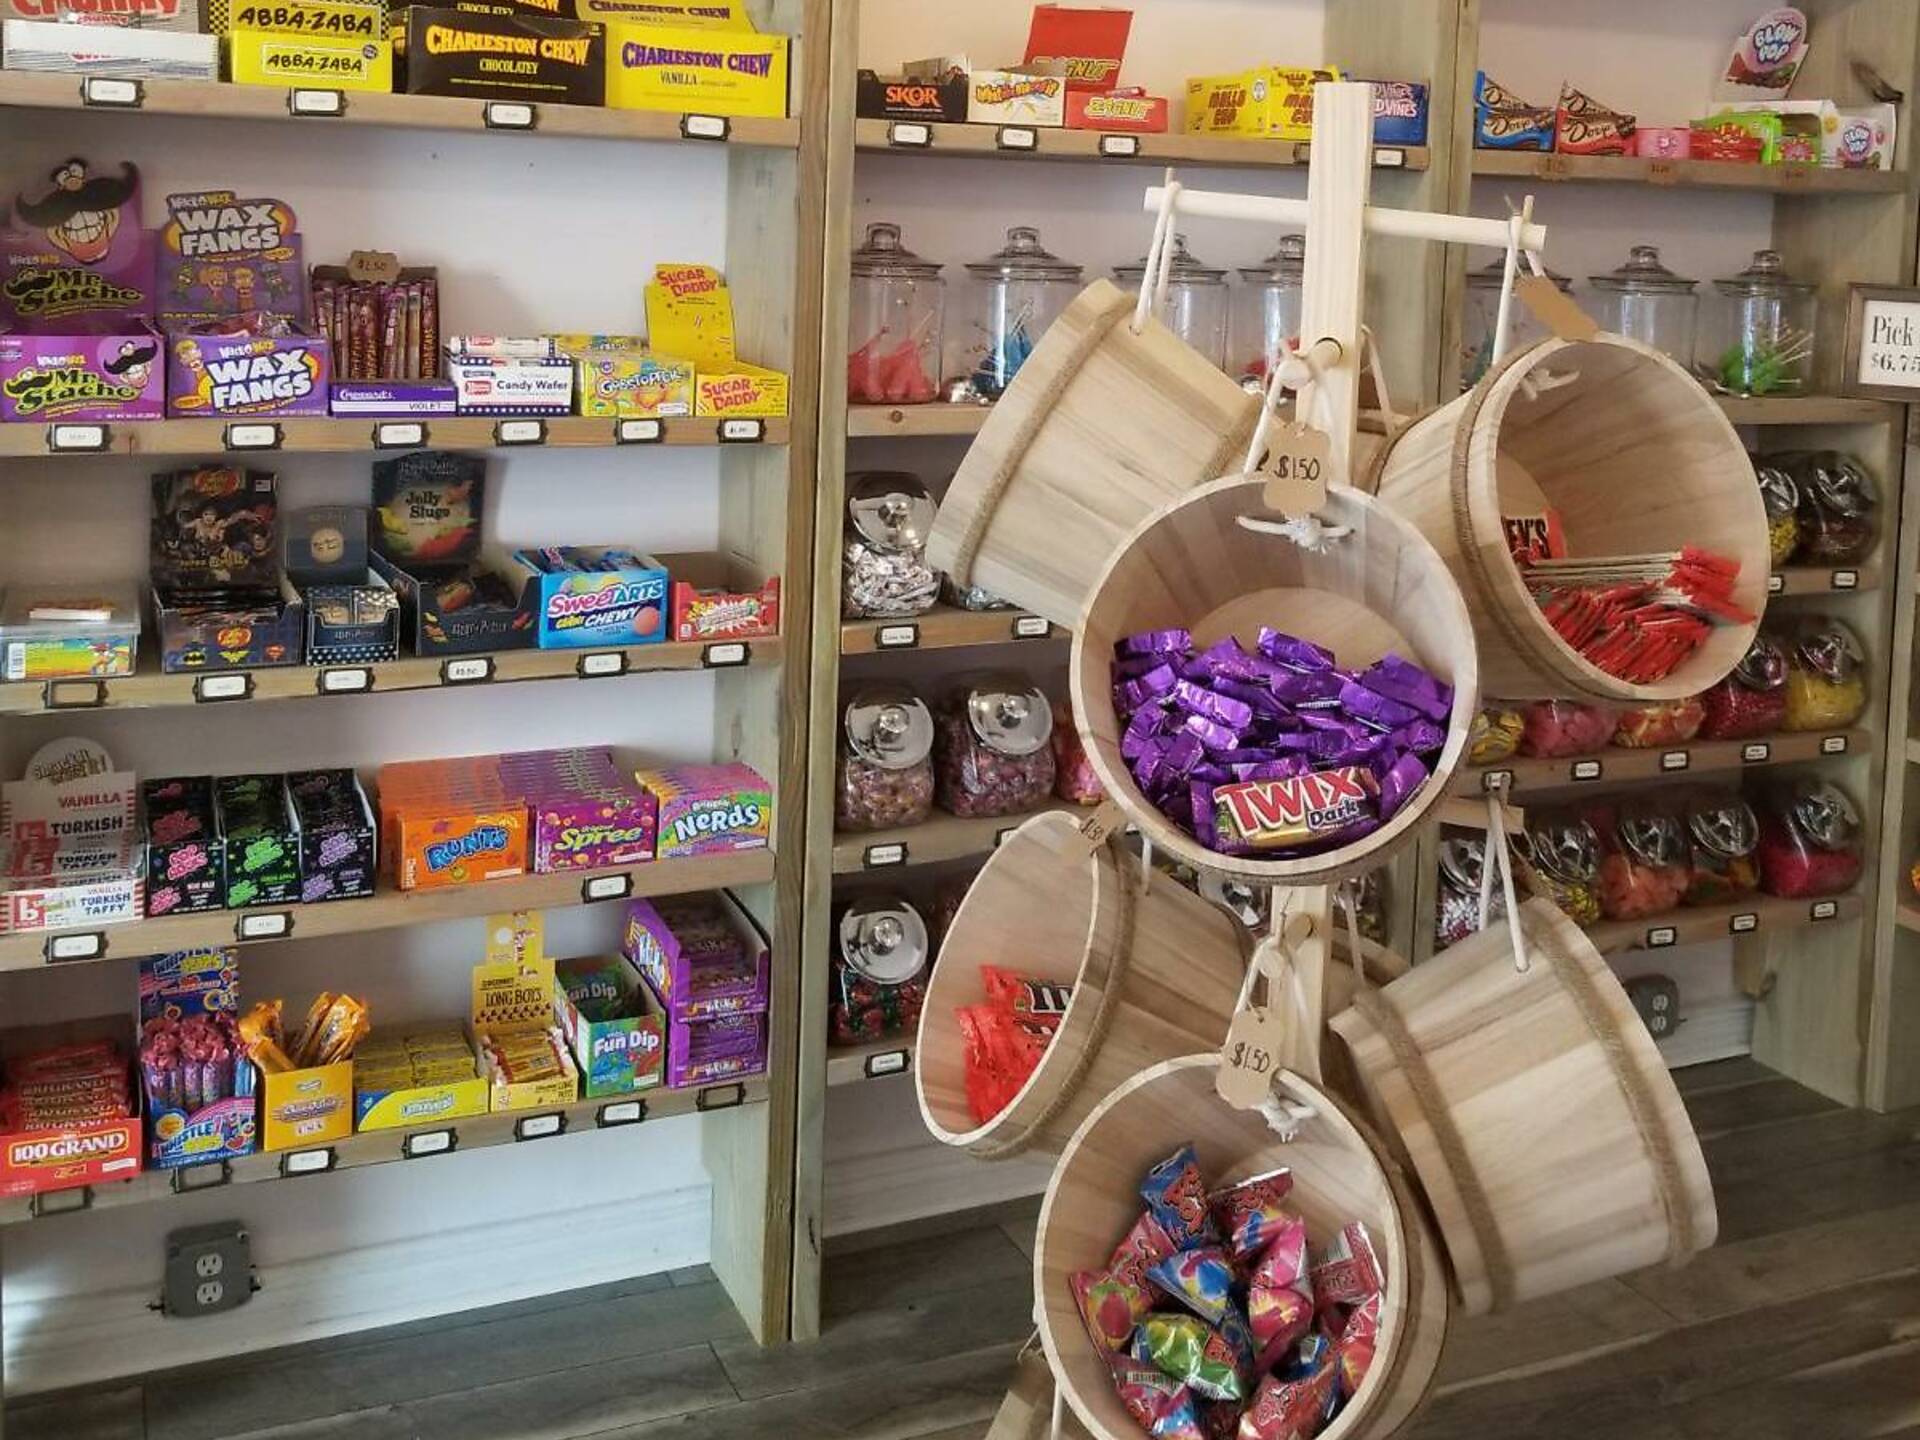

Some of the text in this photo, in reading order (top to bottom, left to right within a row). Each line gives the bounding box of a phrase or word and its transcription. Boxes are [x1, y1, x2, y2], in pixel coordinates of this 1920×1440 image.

[237, 7, 374, 35] ABBA-ZABA
[426, 25, 591, 65] CHARLESTON CHEW
[1753, 22, 1801, 49] BLOW
[267, 54, 363, 73] ABBA-ZABA
[622, 41, 773, 78] CHARLESTON CHEW
[1758, 43, 1791, 63] POP
[479, 58, 539, 75] CHOCOLATEY
[660, 70, 698, 86] VANILLA
[885, 85, 943, 109] SKOR
[177, 204, 276, 231] WAX
[181, 227, 280, 256] FANGS
[656, 268, 705, 287] SUGAR
[671, 280, 717, 297] DADDY
[1872, 316, 1913, 347] Pick
[206, 349, 308, 384] WAX
[212, 372, 313, 410] FANGS
[497, 380, 533, 392] Candy
[535, 380, 568, 391] Wafer
[701, 378, 752, 399] SUGAR
[713, 391, 761, 412] DADDY
[405, 490, 442, 506] Jelly
[584, 606, 640, 627] CHEWY
[58, 793, 121, 808] VANILLA
[1215, 766, 1367, 837] TWIX
[51, 816, 123, 835] TURKISH
[1308, 803, 1360, 829] Dark
[554, 826, 643, 853] Spree
[80, 893, 131, 907] TURKISH
[85, 904, 126, 916] TAFFY
[485, 986, 542, 1007] LONG BOYS
[568, 985, 590, 1000] un
[594, 1029, 660, 1059] Fun Dip
[15, 1132, 125, 1162] 100 GRAND
